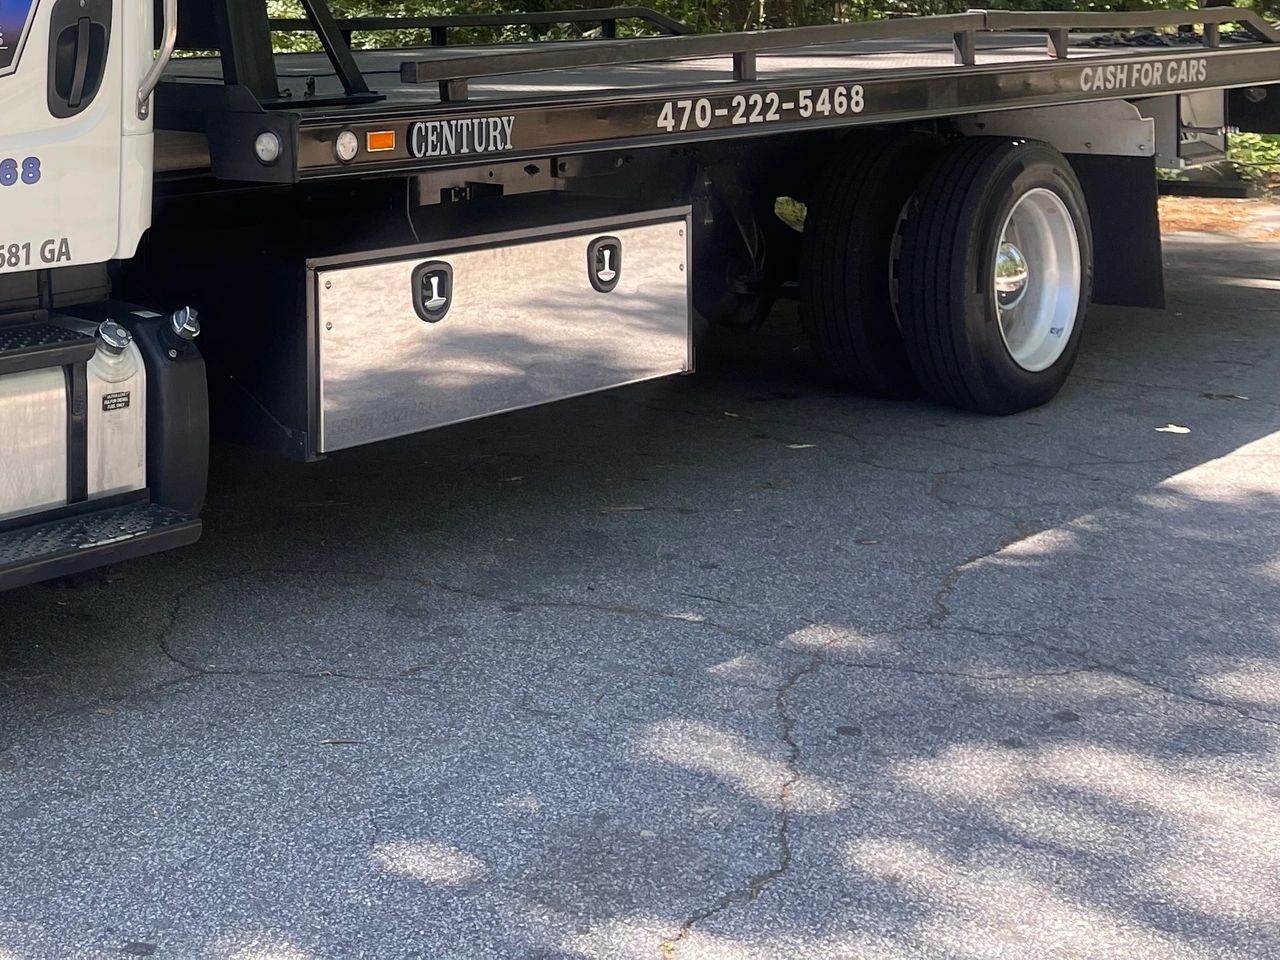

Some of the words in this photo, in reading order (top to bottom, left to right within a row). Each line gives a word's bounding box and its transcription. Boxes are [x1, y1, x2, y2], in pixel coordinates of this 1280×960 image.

[1080, 65, 1128, 92] CASH
[1131, 62, 1163, 88] FOR
[1166, 59, 1208, 84] CARS
[657, 85, 866, 132] 470-222-5468
[411, 115, 516, 158] CENTURY
[40, 238, 72, 264] GA
